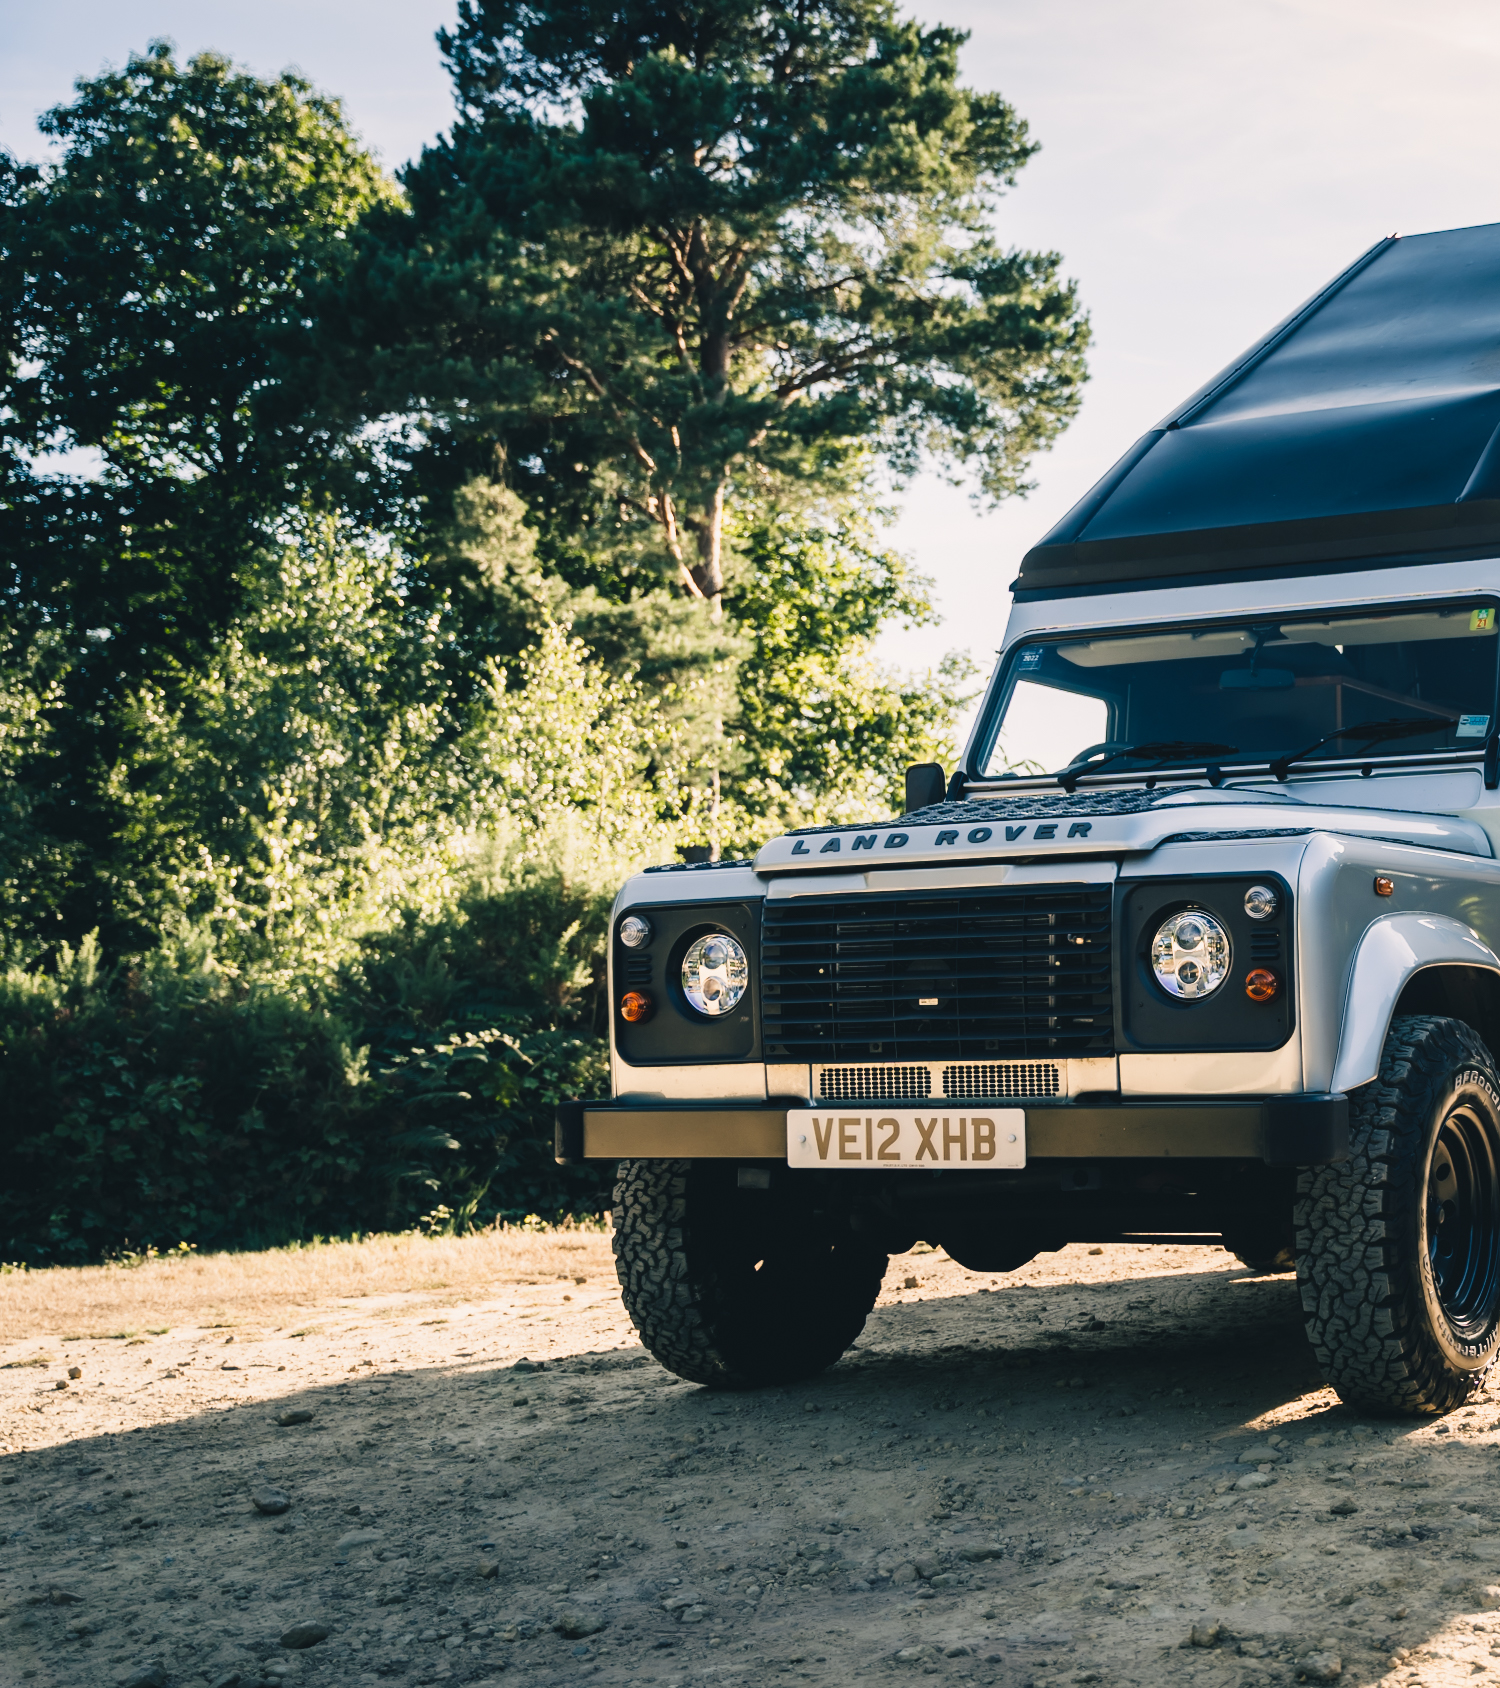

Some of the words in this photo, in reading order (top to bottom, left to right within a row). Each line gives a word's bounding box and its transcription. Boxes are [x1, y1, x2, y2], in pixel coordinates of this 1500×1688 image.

[1022, 654, 1040, 662] 2022
[791, 832, 910, 856] LAND
[934, 821, 1093, 846] ROVER
[811, 1117, 901, 1161] VE12
[914, 1117, 997, 1162] XHB
